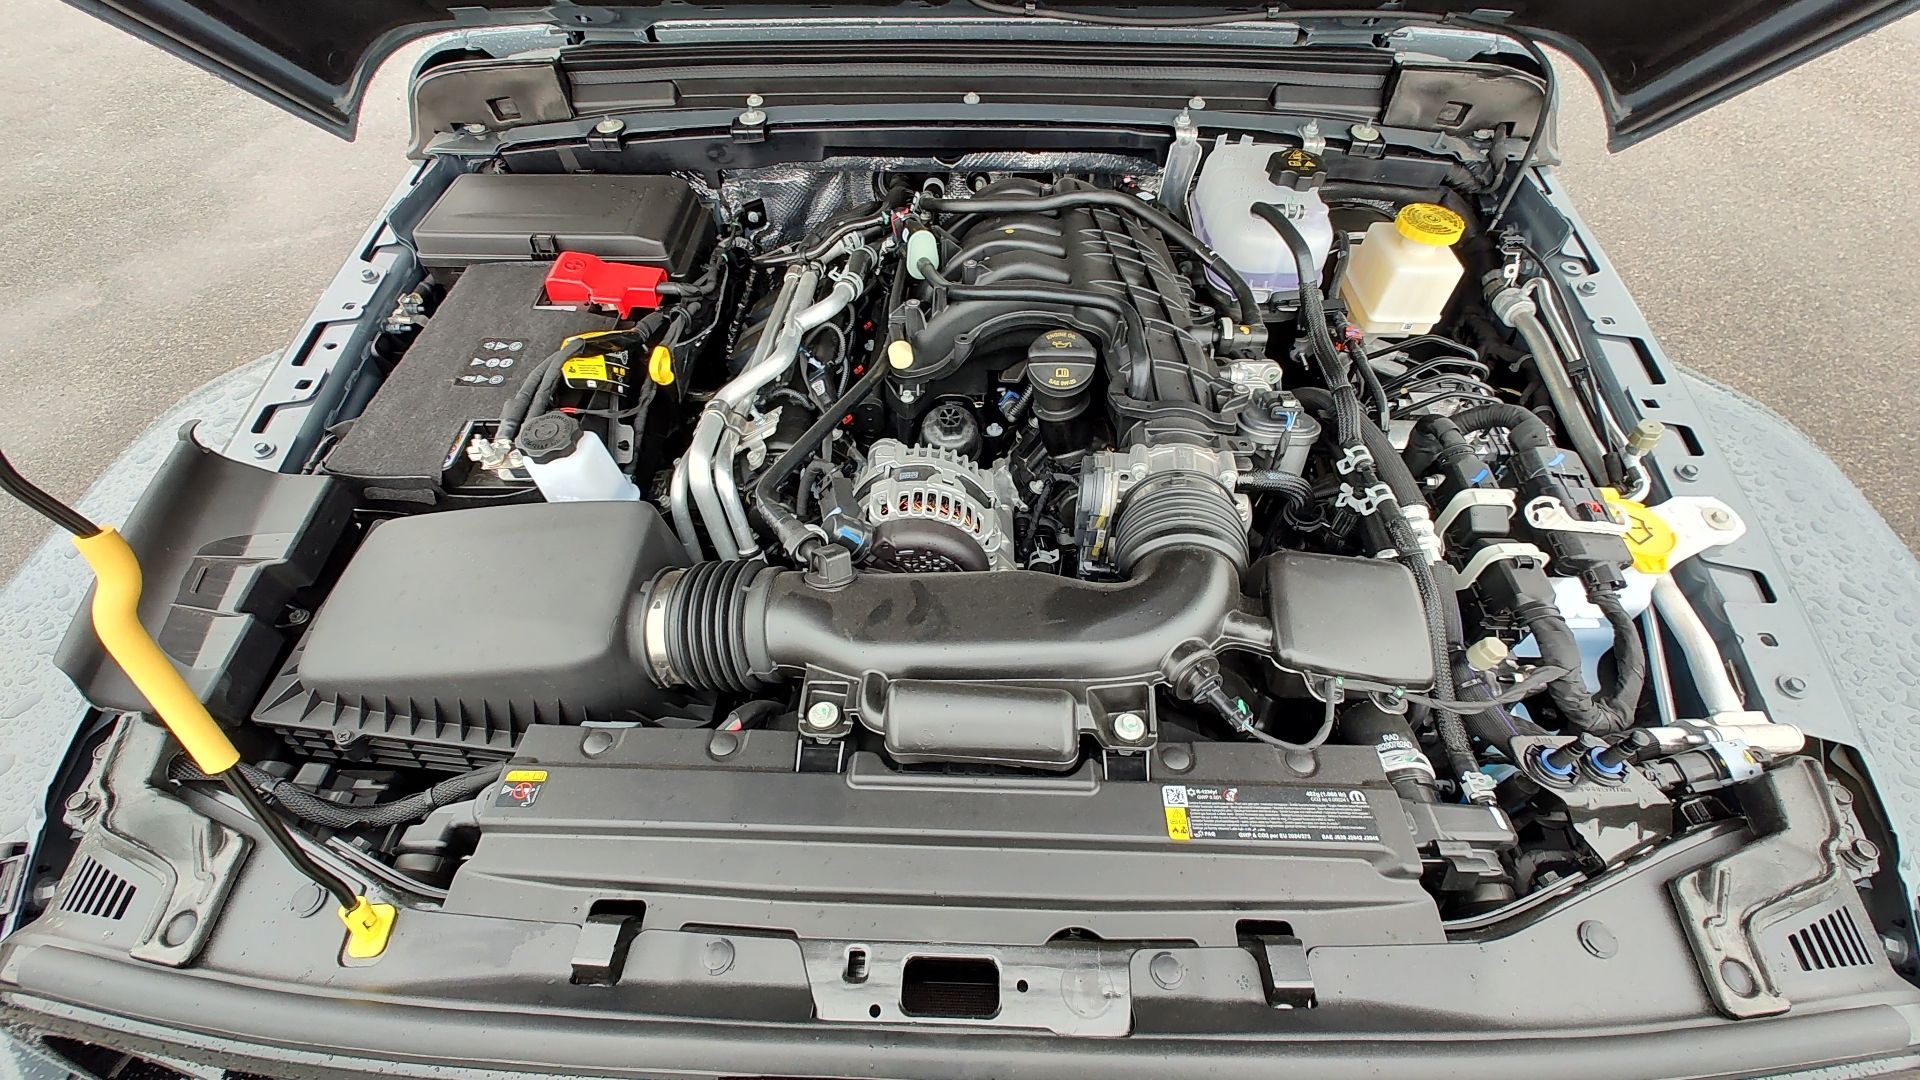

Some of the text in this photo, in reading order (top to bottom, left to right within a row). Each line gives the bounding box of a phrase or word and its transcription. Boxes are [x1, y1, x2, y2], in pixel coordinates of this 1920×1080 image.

[1045, 331, 1077, 340] ENGINE OIL
[1048, 378, 1077, 386] SAE 0W-20
[1382, 733, 1399, 743] RAD
